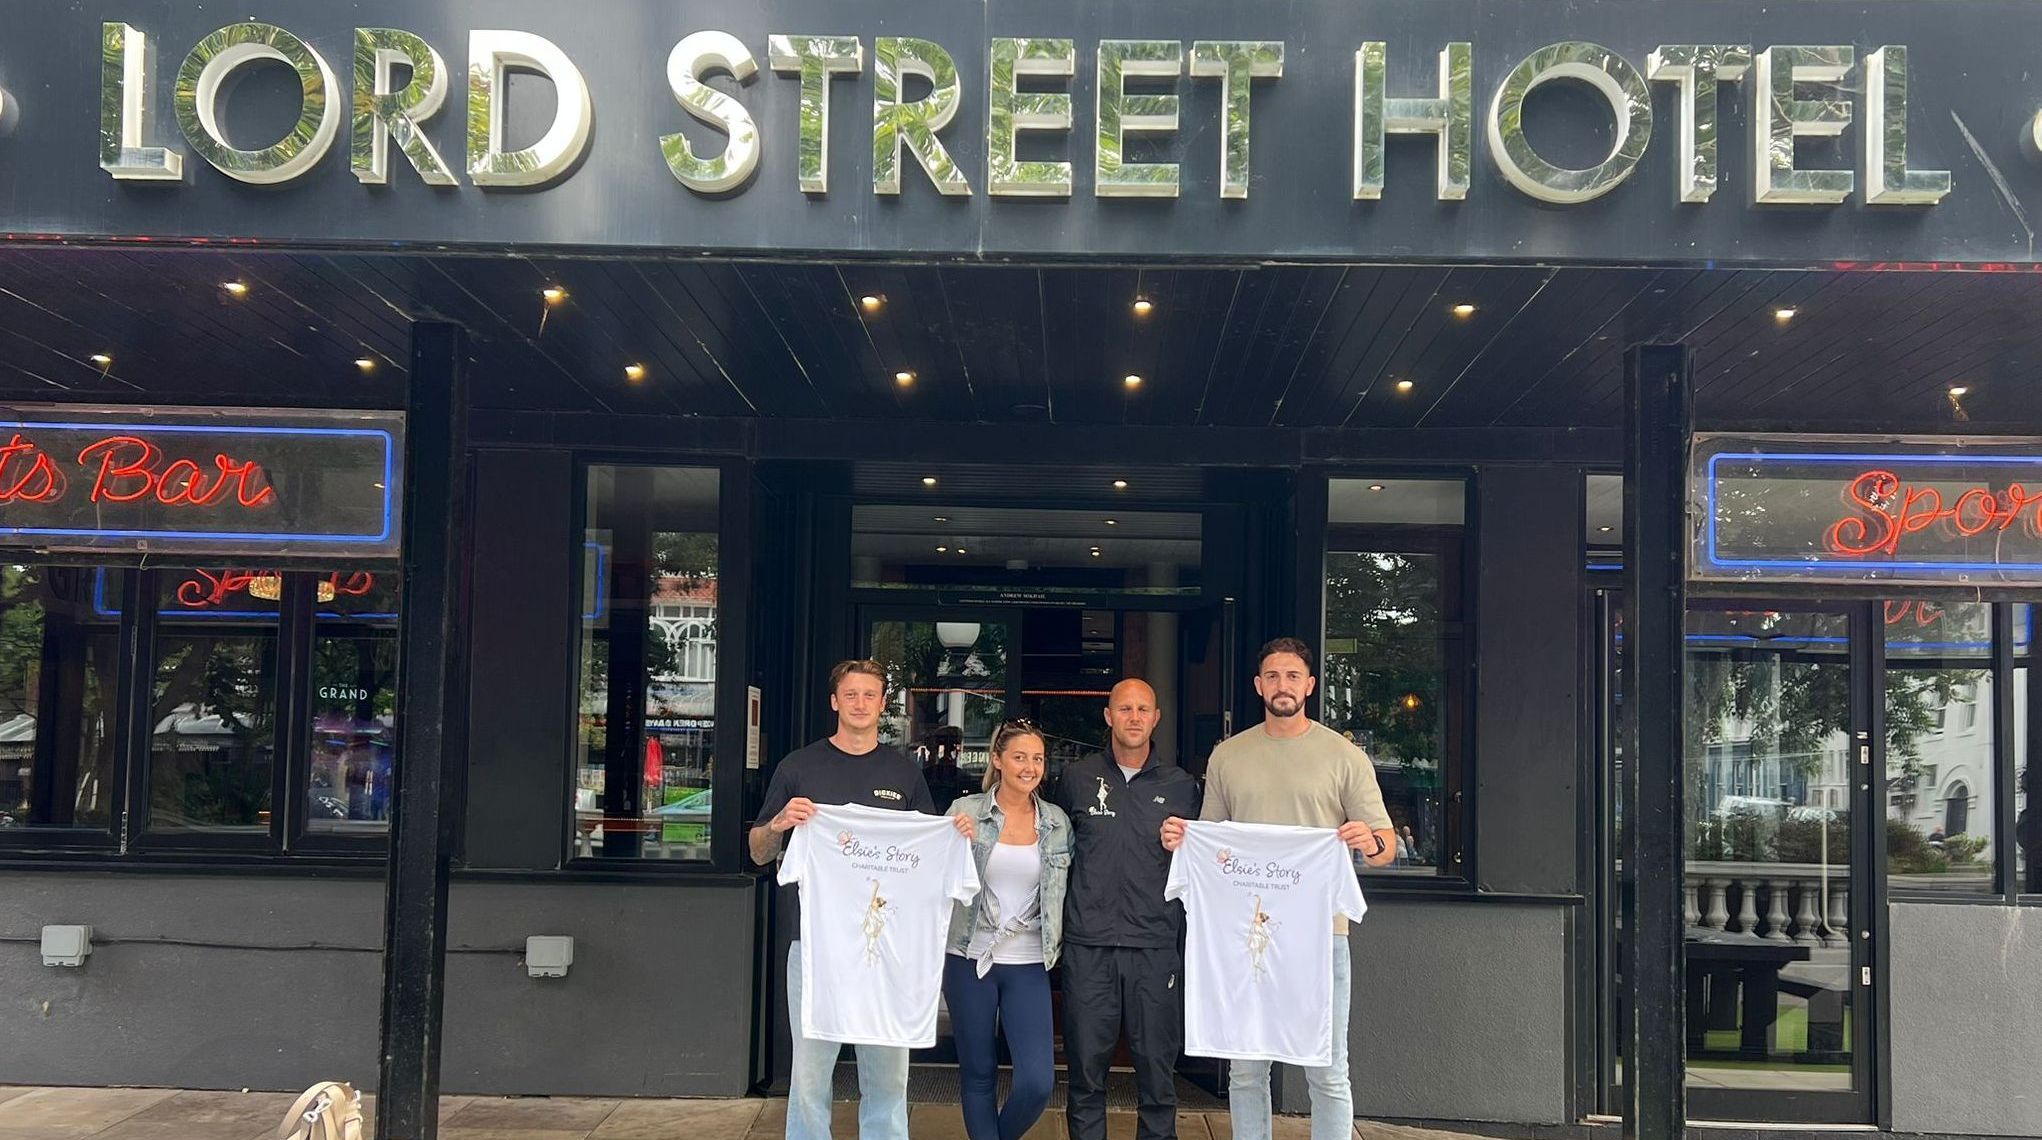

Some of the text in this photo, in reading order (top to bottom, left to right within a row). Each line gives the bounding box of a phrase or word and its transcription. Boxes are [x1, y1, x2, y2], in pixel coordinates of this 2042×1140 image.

[100, 21, 1951, 204] LORD STREET HOTEL
[78, 436, 273, 507] Bar
[320, 687, 368, 700] GRAND
[843, 841, 920, 868] Elsie's Story
[852, 862, 888, 872] CHARITABLE
[1223, 859, 1301, 885] Elsie's Story
[1232, 880, 1268, 889] CHARITABLE
